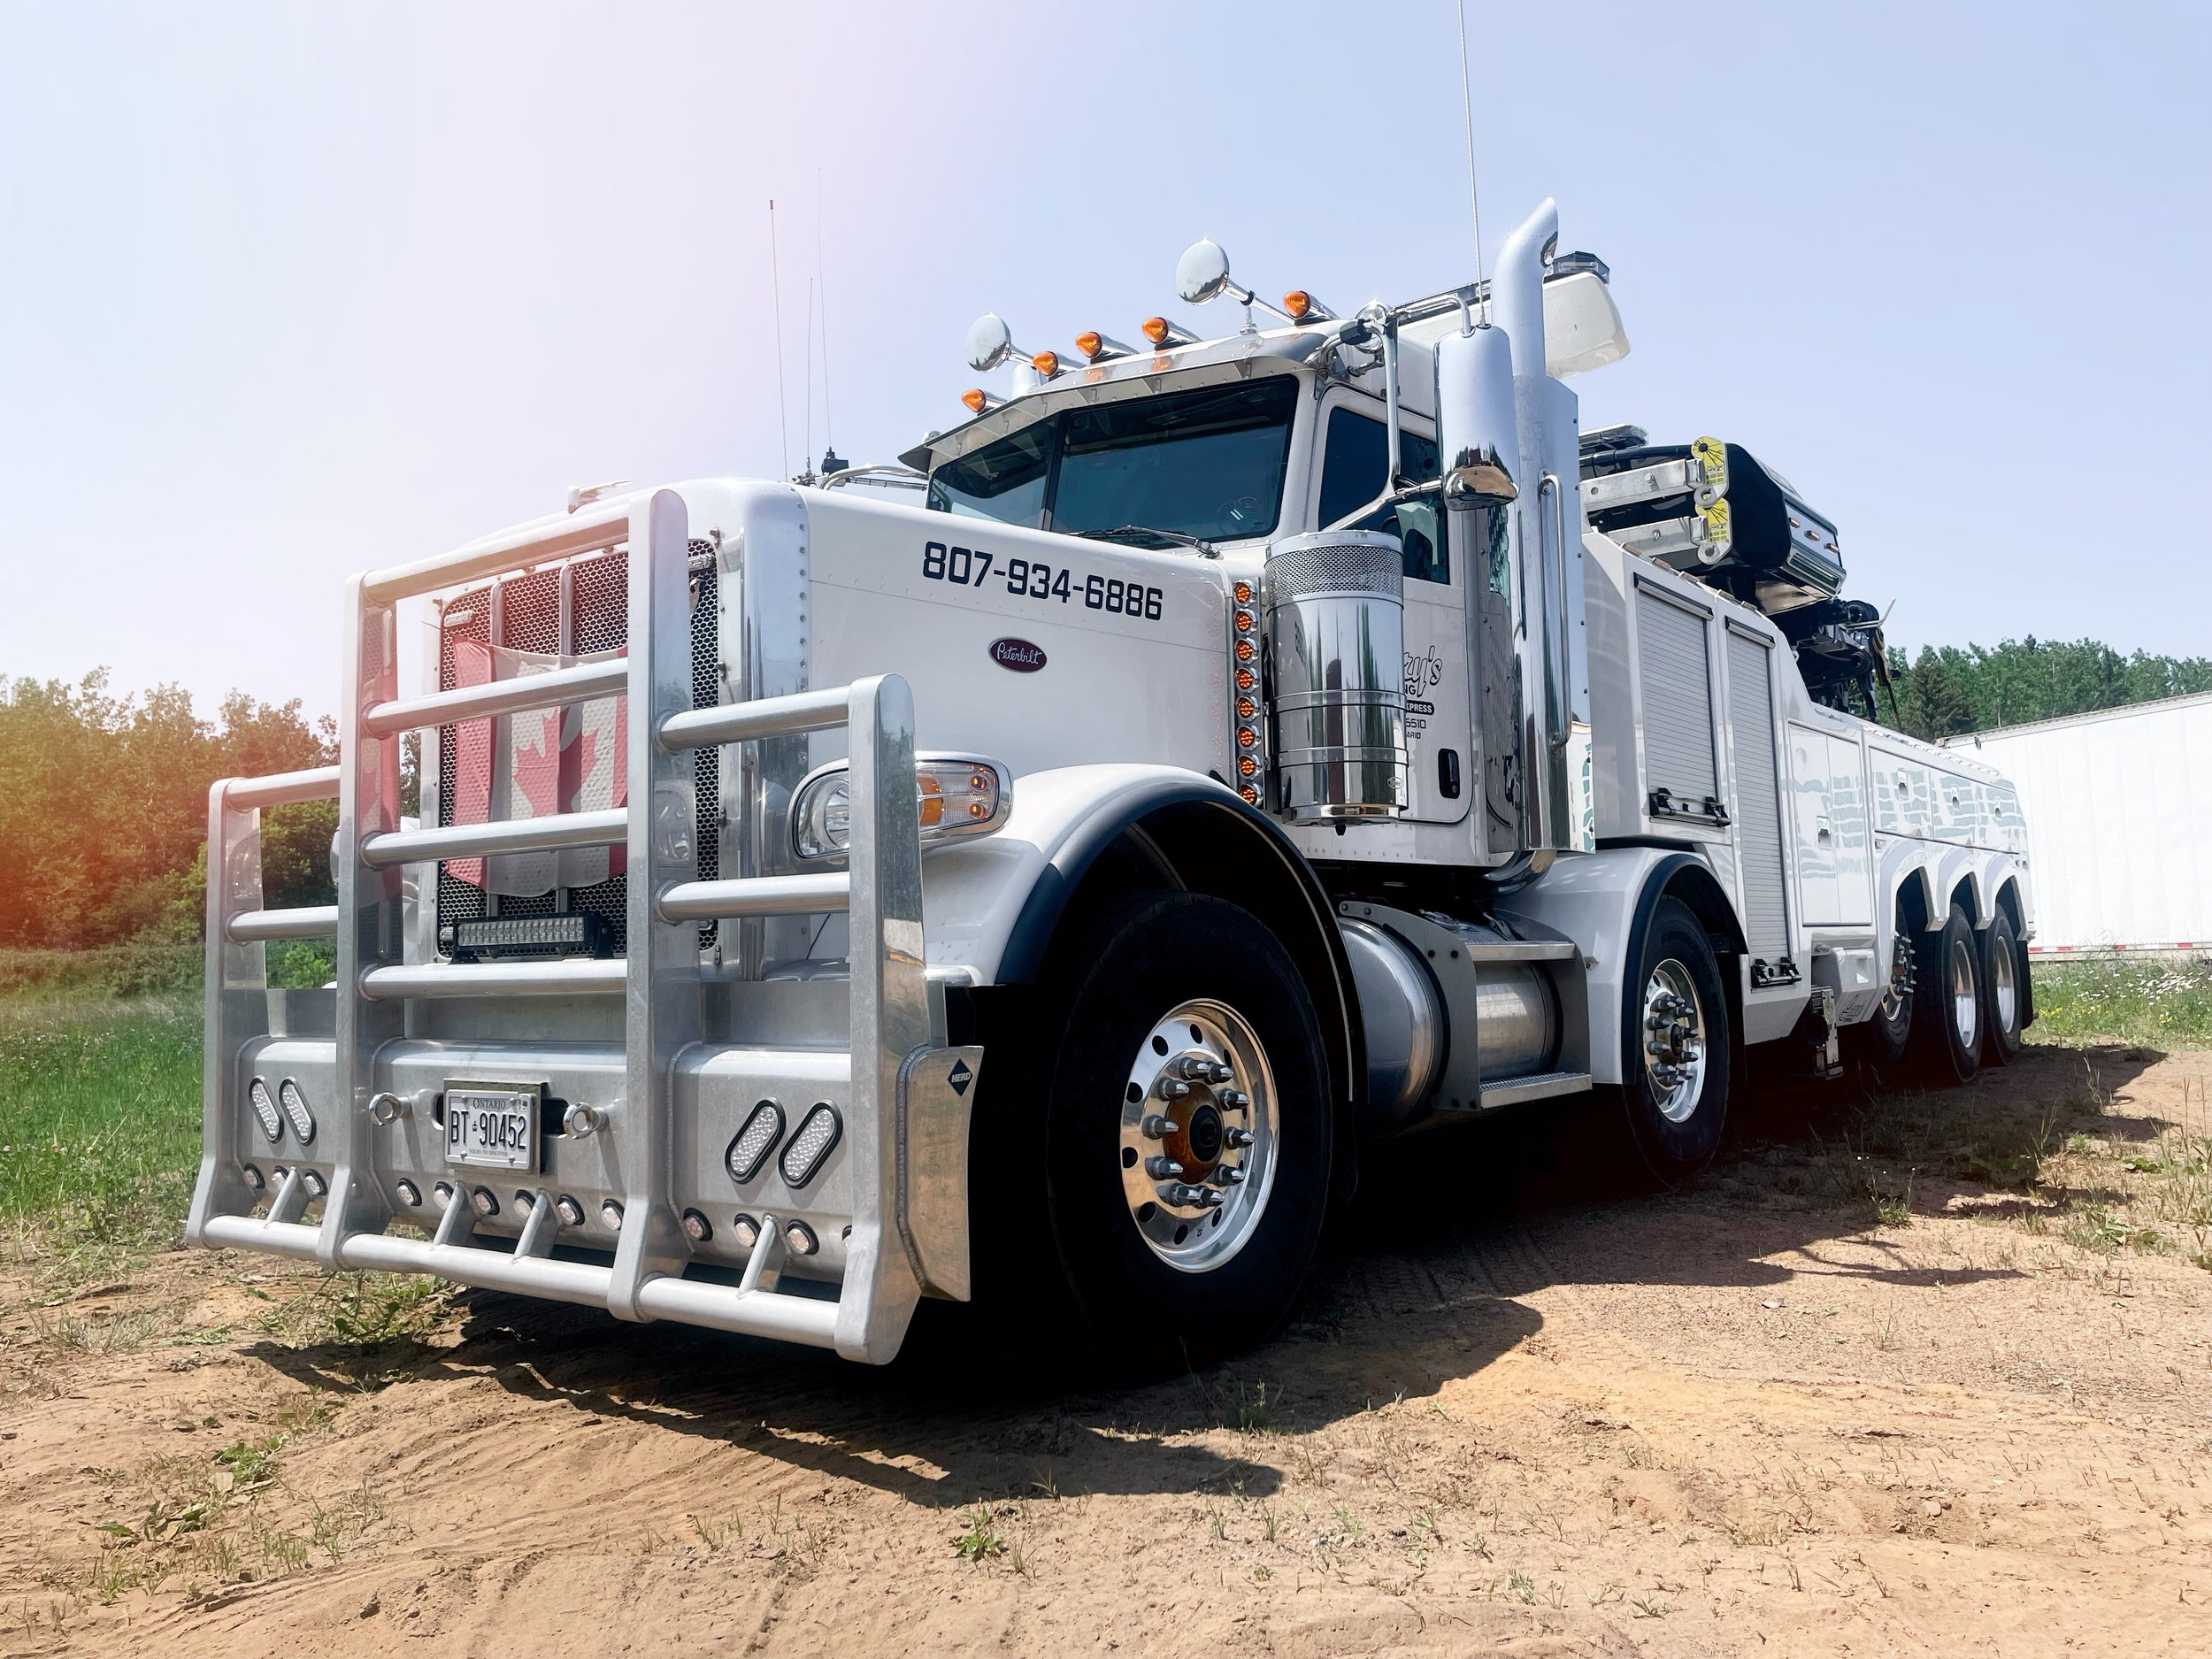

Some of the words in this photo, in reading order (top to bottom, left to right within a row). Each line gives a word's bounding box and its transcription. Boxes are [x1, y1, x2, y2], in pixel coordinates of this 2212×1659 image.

[923, 541, 1163, 621] 807-934-6886
[997, 641, 1042, 664] Peterbilt
[1404, 645, 1443, 698] ry's
[1406, 731, 1421, 740] ARIO
[951, 1071, 972, 1083] HERD
[472, 1097, 506, 1110] ONTARIO
[451, 1110, 469, 1145] BT
[480, 1112, 526, 1150] 90452
